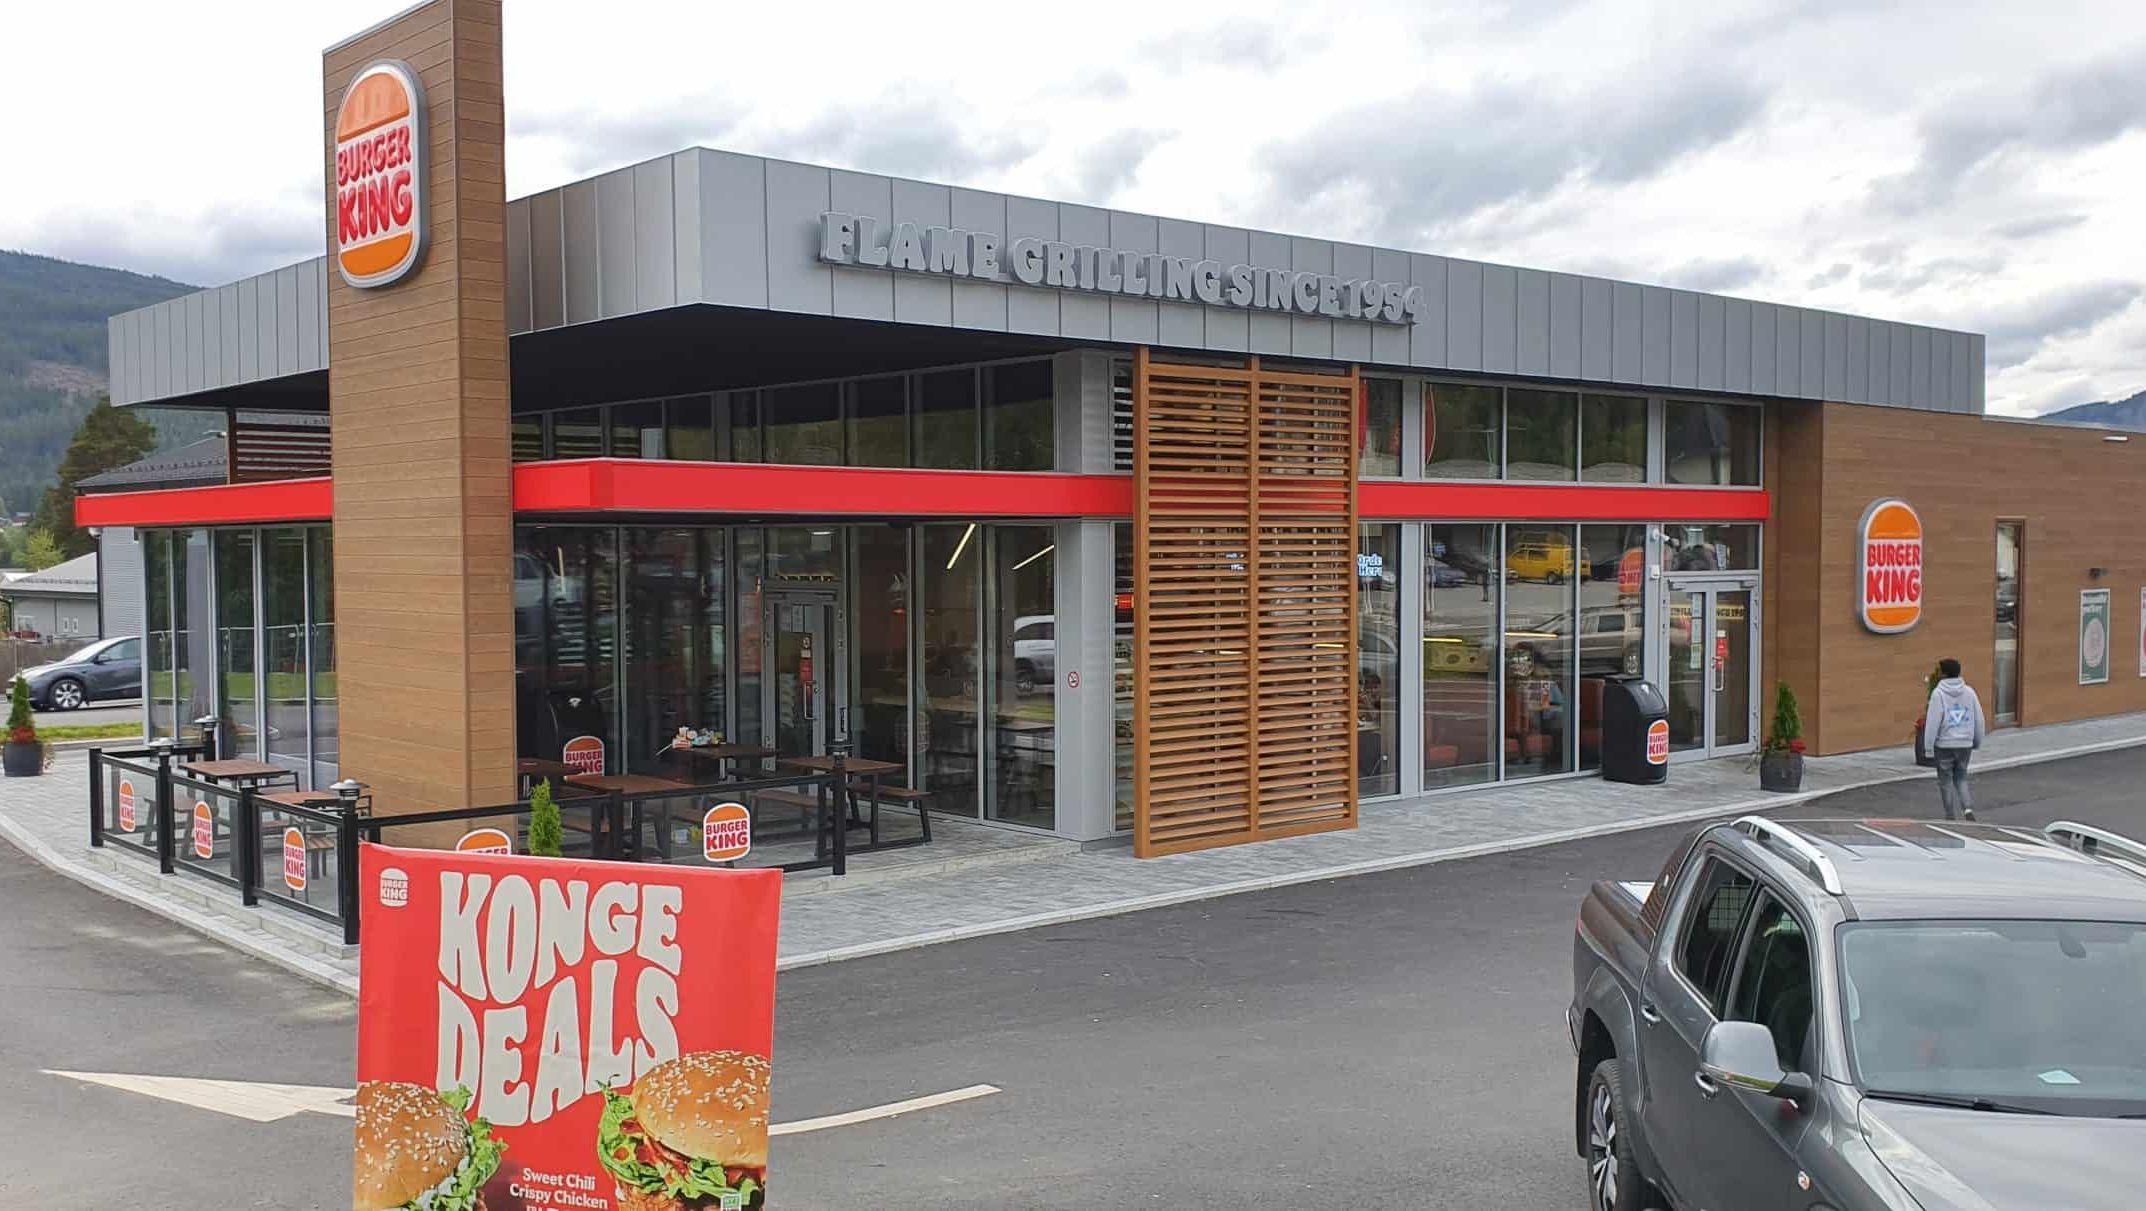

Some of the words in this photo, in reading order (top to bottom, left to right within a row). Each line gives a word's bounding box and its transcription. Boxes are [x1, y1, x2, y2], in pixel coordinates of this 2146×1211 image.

[338, 125, 411, 187] BURGER
[338, 170, 413, 245] KING
[818, 210, 999, 279] FLAME
[1010, 237, 1222, 303] GRILLING
[1226, 263, 1341, 315] SINCE
[1345, 279, 1427, 327] 1954
[1867, 543, 1920, 567] BURGER
[1866, 569, 1920, 604] KING
[565, 750, 602, 761] BURGER
[705, 820, 748, 835] BURGER
[706, 831, 748, 849] KING
[285, 859, 305, 878] KING
[382, 888, 408, 901] KING
[438, 871, 682, 1004] KONGE
[436, 959, 680, 1127] DEALS
[522, 1168, 564, 1186] Sweet
[566, 1173, 596, 1190] Chili
[509, 1183, 551, 1202] Crispy
[554, 1192, 608, 1210] Chicken
